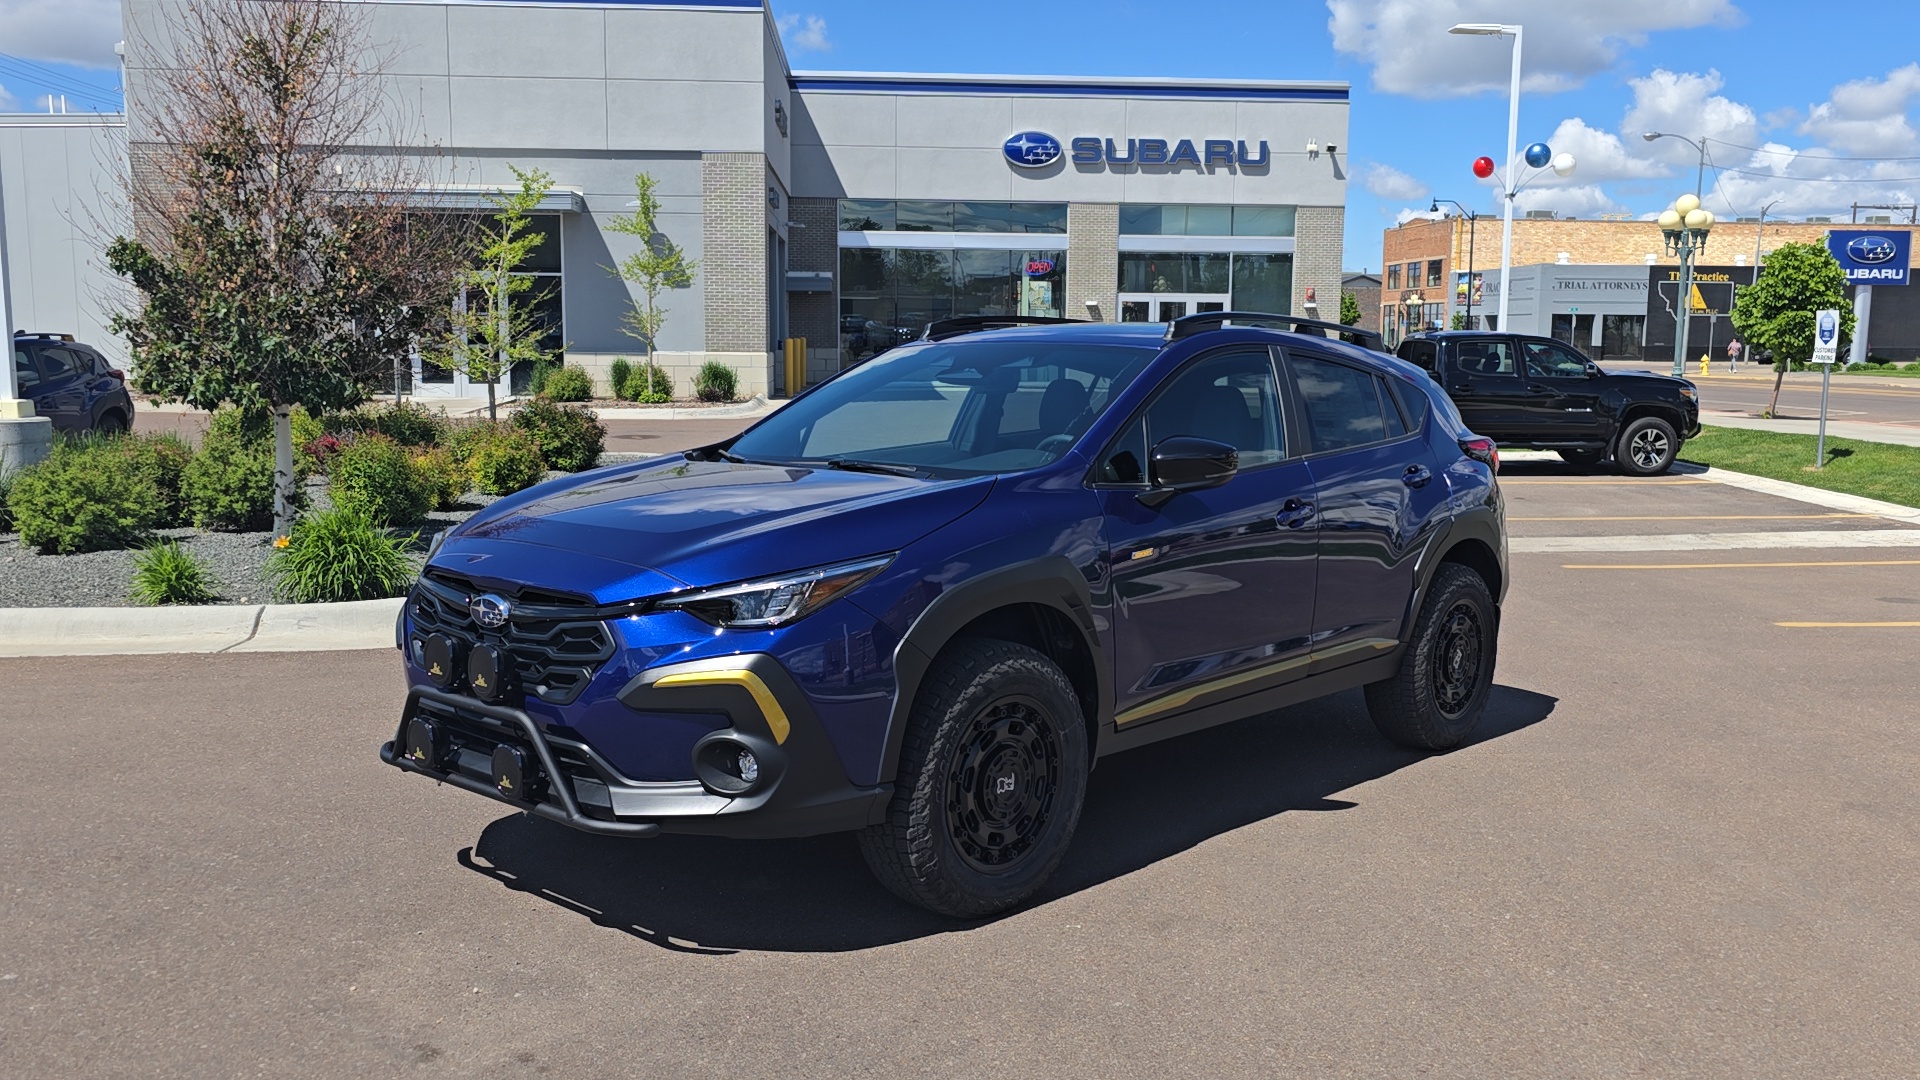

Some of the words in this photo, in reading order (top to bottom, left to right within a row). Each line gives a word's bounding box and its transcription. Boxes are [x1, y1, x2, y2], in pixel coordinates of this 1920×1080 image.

[1071, 137, 1268, 166] SUBARU
[1027, 262, 1051, 273] OPEN
[1668, 271, 1688, 281] Th
[1846, 268, 1903, 279] UBARU
[1557, 281, 1588, 290] TRIAL
[1590, 281, 1648, 290] ATTORNEYS
